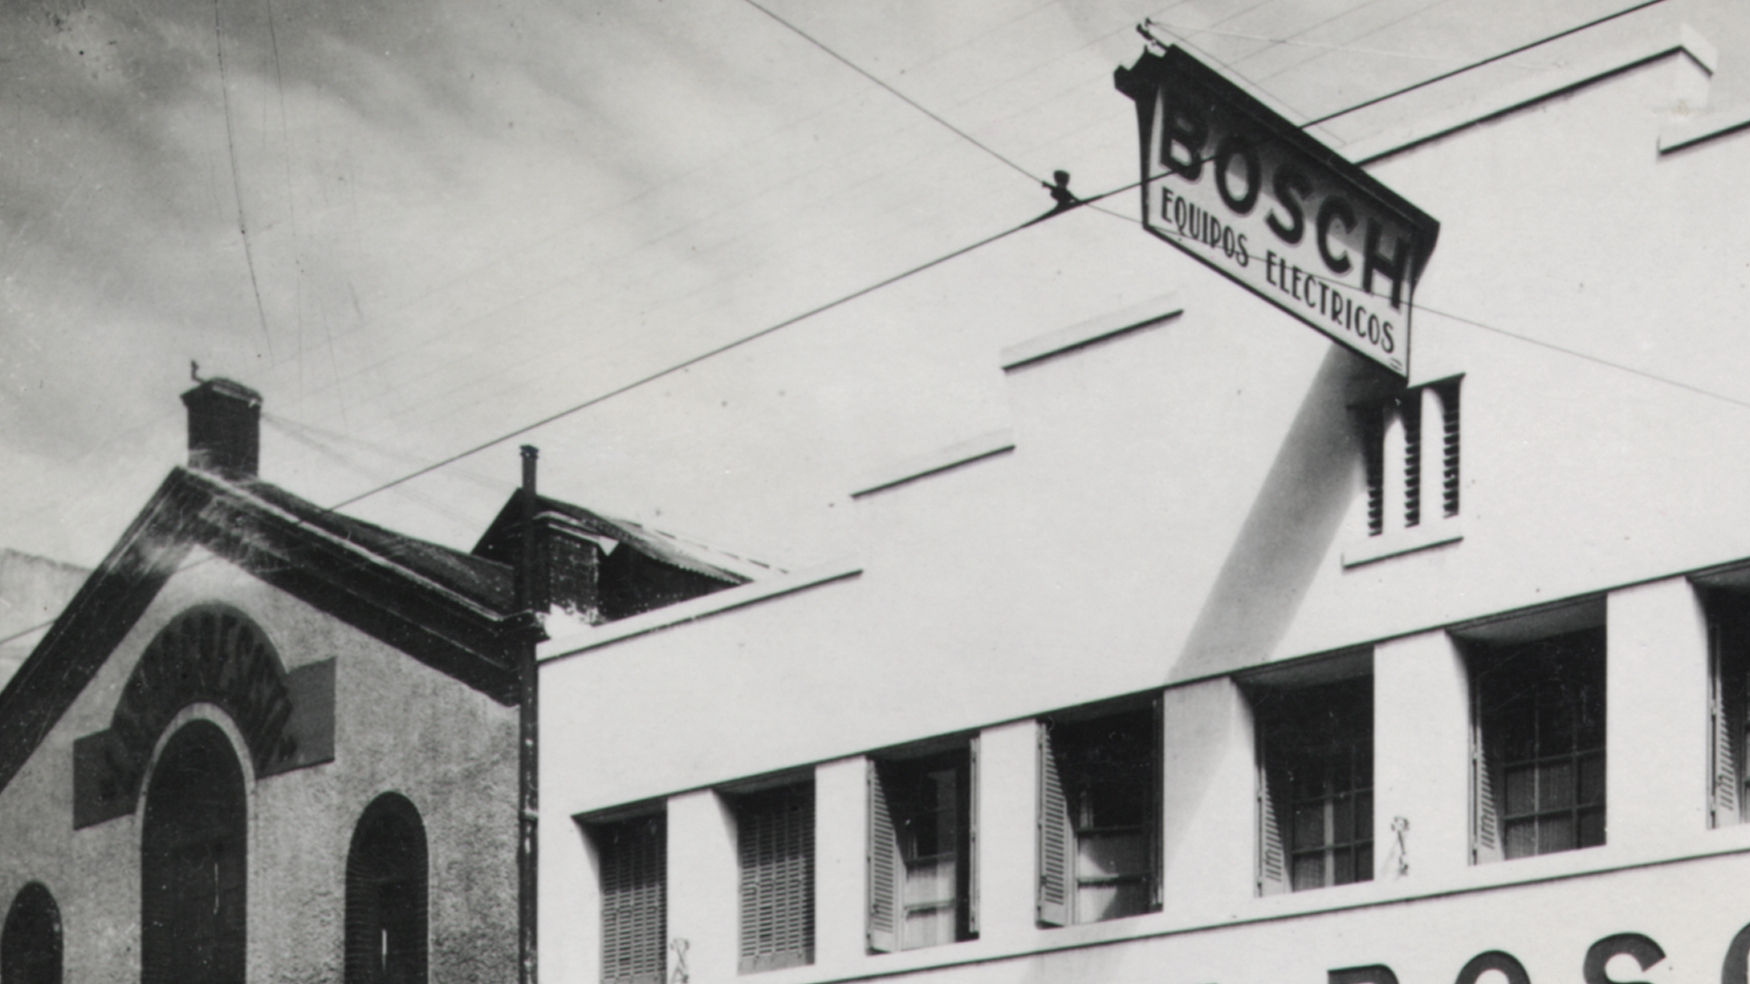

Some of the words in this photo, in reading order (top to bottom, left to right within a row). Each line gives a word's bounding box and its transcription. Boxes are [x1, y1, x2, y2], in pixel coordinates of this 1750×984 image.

[1160, 104, 1407, 312] BOSCH
[1161, 187, 1249, 268] EQUIPOS
[1265, 249, 1396, 354] ELECTRICOS
